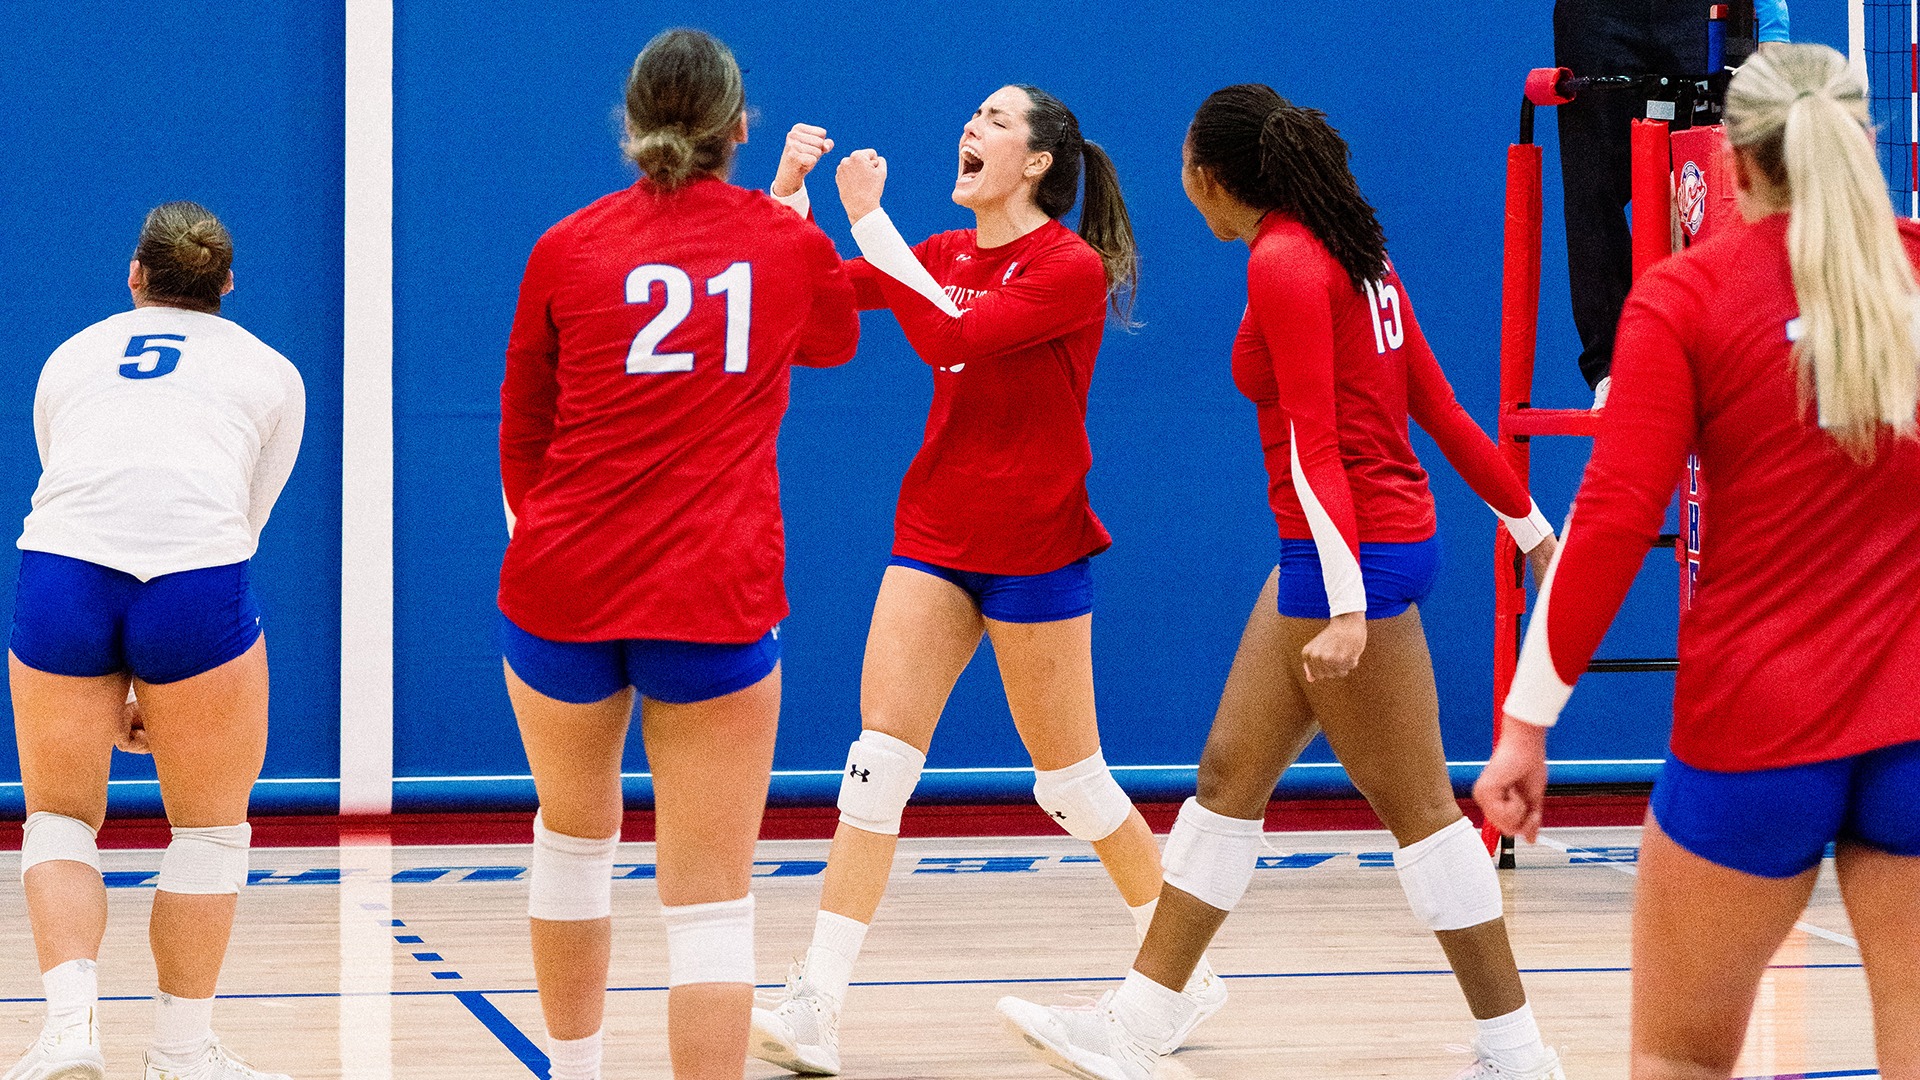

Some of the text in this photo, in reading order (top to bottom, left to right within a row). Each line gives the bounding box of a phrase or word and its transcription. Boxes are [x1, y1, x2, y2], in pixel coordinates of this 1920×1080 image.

[624, 261, 752, 374] 21
[1361, 260, 1404, 354] 15
[118, 333, 186, 380] 5
